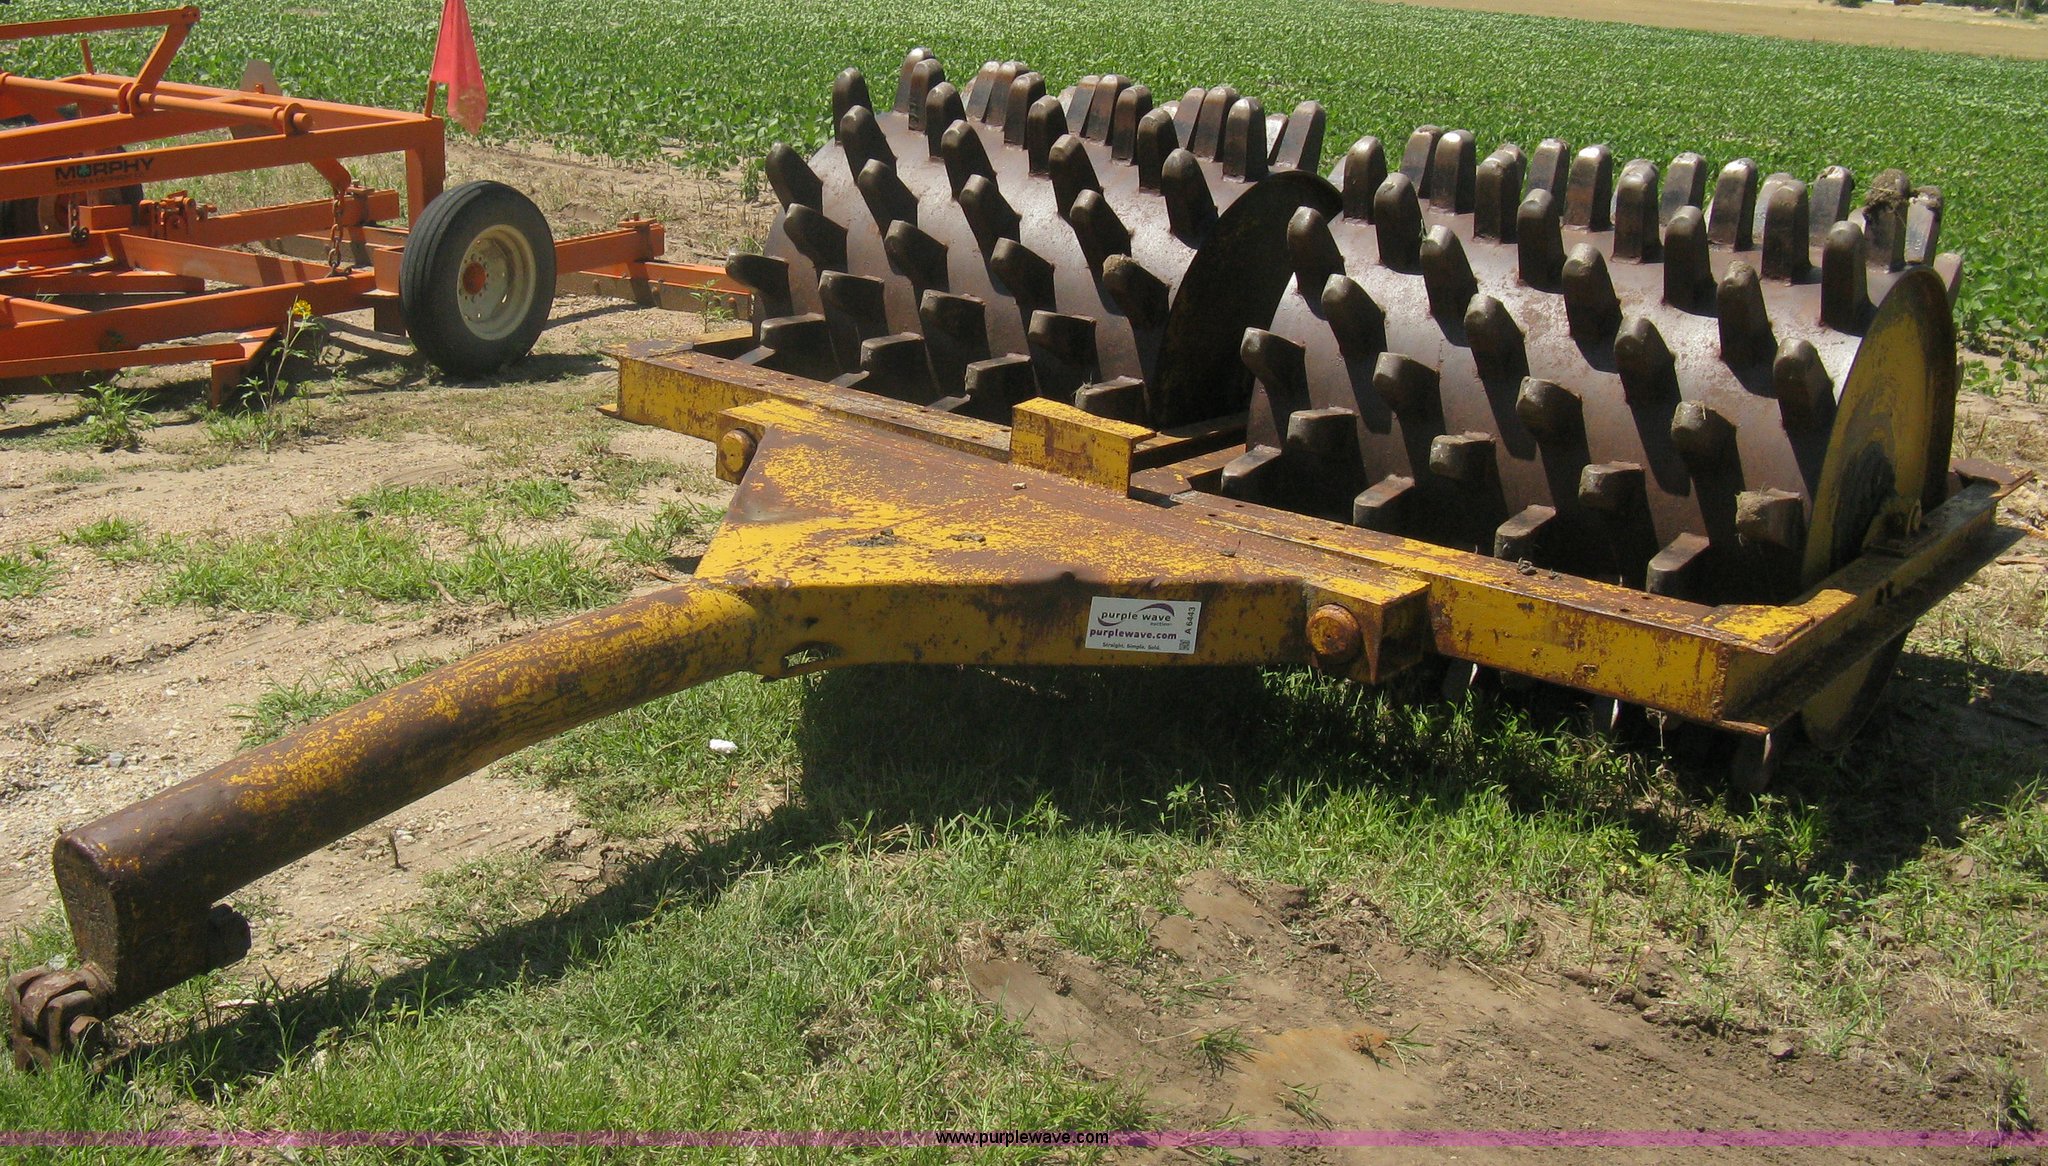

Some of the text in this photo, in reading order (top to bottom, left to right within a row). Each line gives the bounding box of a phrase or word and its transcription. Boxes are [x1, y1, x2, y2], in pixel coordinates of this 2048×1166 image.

[1101, 611, 1138, 621] purple
[1186, 606, 1196, 627] 6443
[1089, 628, 1177, 640] purplewave.com
